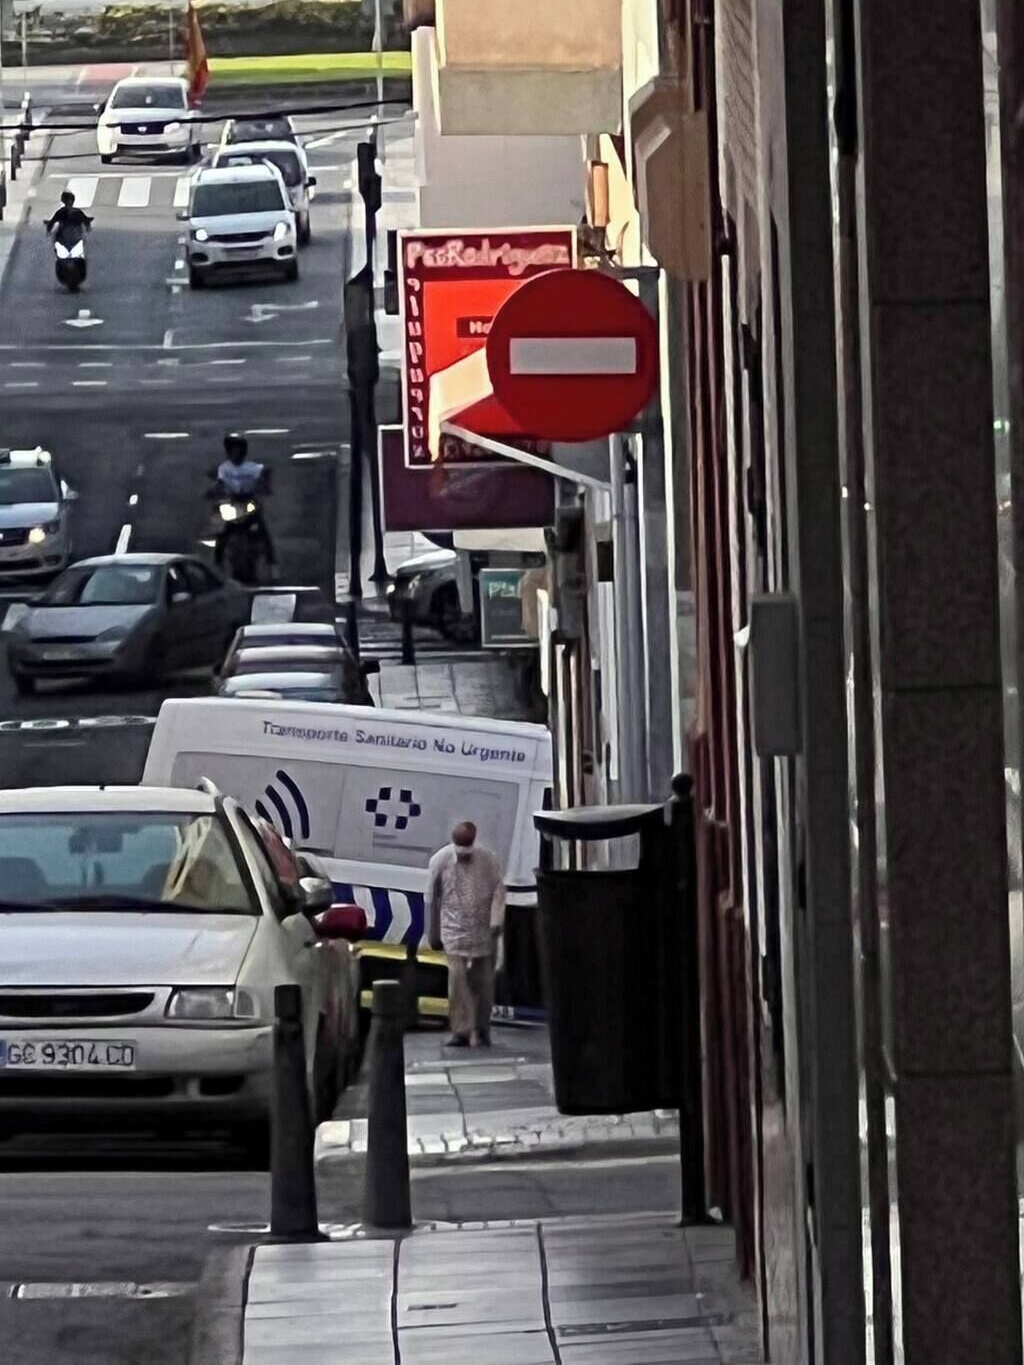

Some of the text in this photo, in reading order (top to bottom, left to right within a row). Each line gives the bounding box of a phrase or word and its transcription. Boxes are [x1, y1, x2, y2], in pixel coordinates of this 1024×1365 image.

[262, 720, 526, 763] Transporte Sanitario No Urgente
